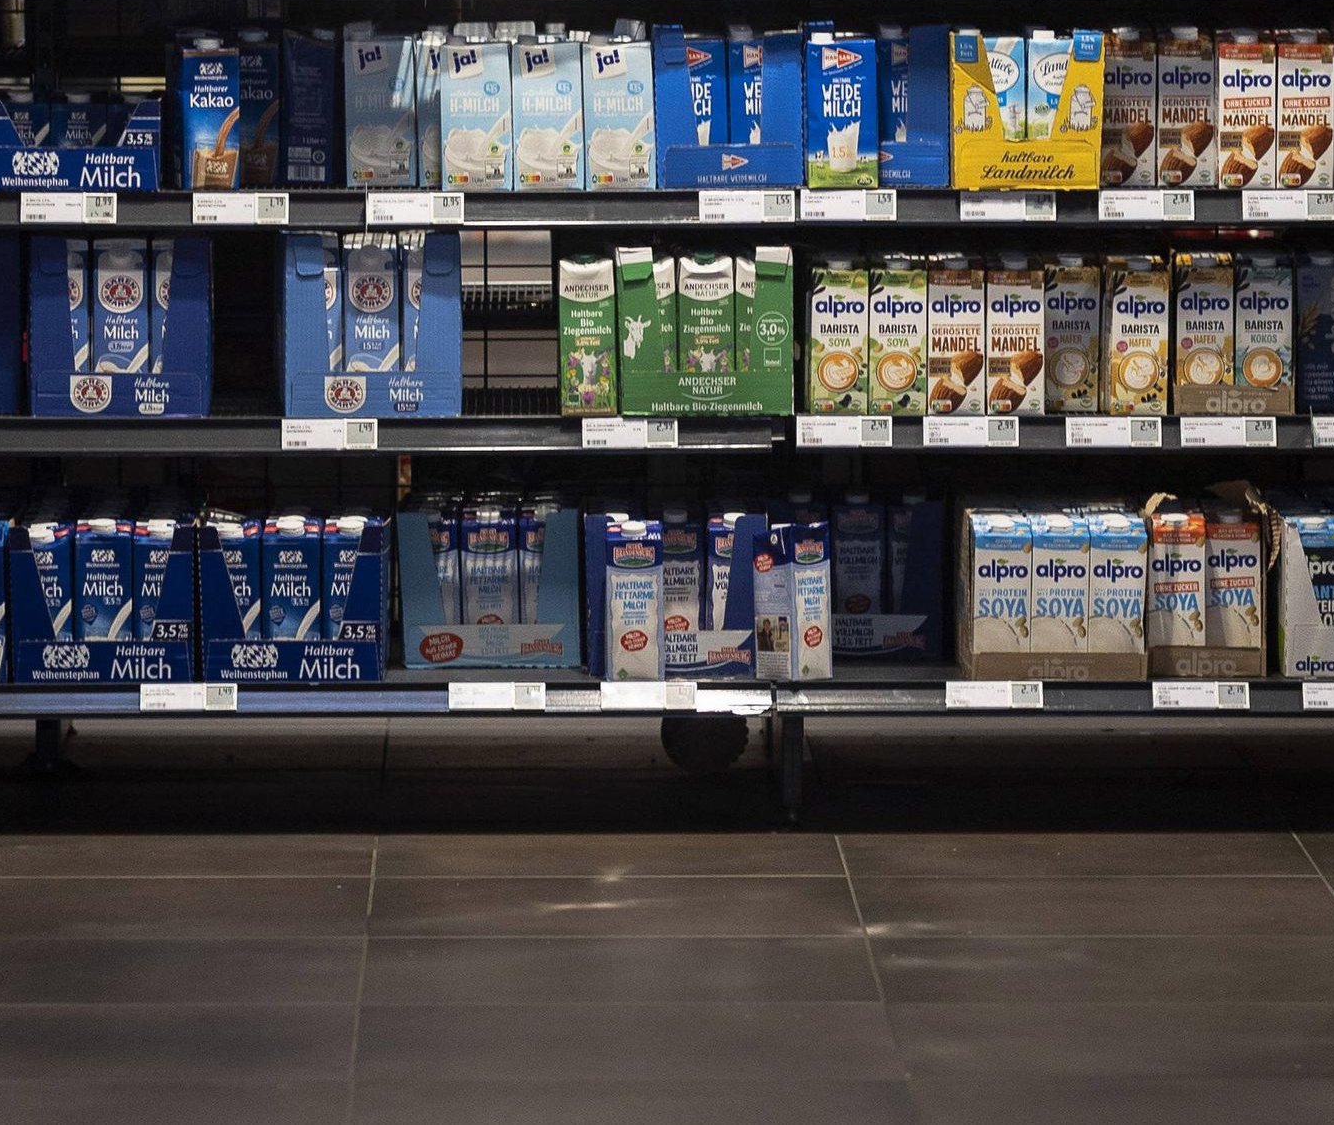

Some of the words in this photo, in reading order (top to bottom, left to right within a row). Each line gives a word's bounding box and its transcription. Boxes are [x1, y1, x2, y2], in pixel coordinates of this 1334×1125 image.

[452, 49, 477, 73] ja!
[1222, 69, 1273, 92] alpro
[1281, 69, 1331, 92] alpro
[822, 83, 861, 101] WEIDE
[189, 93, 234, 108] Kakao
[823, 100, 861, 118] MILCH
[1222, 114, 1272, 127] MANDEL
[1281, 114, 1331, 126] MANDEL
[85, 153, 135, 165] Haltbare
[79, 166, 141, 188] Milch
[980, 164, 1076, 180] Landmilch
[1, 176, 69, 187] Weihenstephan
[565, 283, 609, 292] ANDECHSER
[684, 282, 729, 291] ANDECHSER
[814, 295, 865, 318] alpro
[873, 295, 923, 318] alpro
[931, 295, 981, 318] alpro
[991, 295, 1041, 318] alpro
[1116, 295, 1166, 318] alpro
[104, 325, 139, 340] Milch
[354, 325, 391, 340] Milch
[563, 326, 612, 336] Ziegenmilch
[683, 324, 731, 334] Ziegenmilch
[820, 324, 860, 334] BARISTA
[878, 324, 918, 334] BARISTA
[1121, 324, 1160, 335] BARISTA
[1185, 320, 1225, 331] BARISTA
[931, 337, 981, 352] MANDEL
[991, 337, 1041, 352] MANDEL
[1250, 334, 1278, 344] KOKOS
[678, 376, 737, 386] ANDECHSER
[691, 385, 723, 395] NATUR
[651, 402, 690, 412] Haltbare
[692, 402, 763, 412] Bio-Ziegenmilch
[270, 582, 312, 598] Milch
[614, 591, 655, 600] FETTARME
[992, 588, 1028, 597] PROTEIN
[623, 601, 647, 610] MILCH
[978, 598, 1028, 618] SOYA
[1036, 598, 1085, 618] SOYA
[1093, 598, 1142, 618] SOYA
[1154, 593, 1199, 612] SOYA
[116, 645, 166, 657] Haltbare
[304, 645, 355, 657] Haltbare
[31, 669, 100, 681] Weihenstephan
[110, 658, 172, 680] Milch
[220, 669, 289, 681] Weihenstephan
[298, 658, 361, 680] Milch
